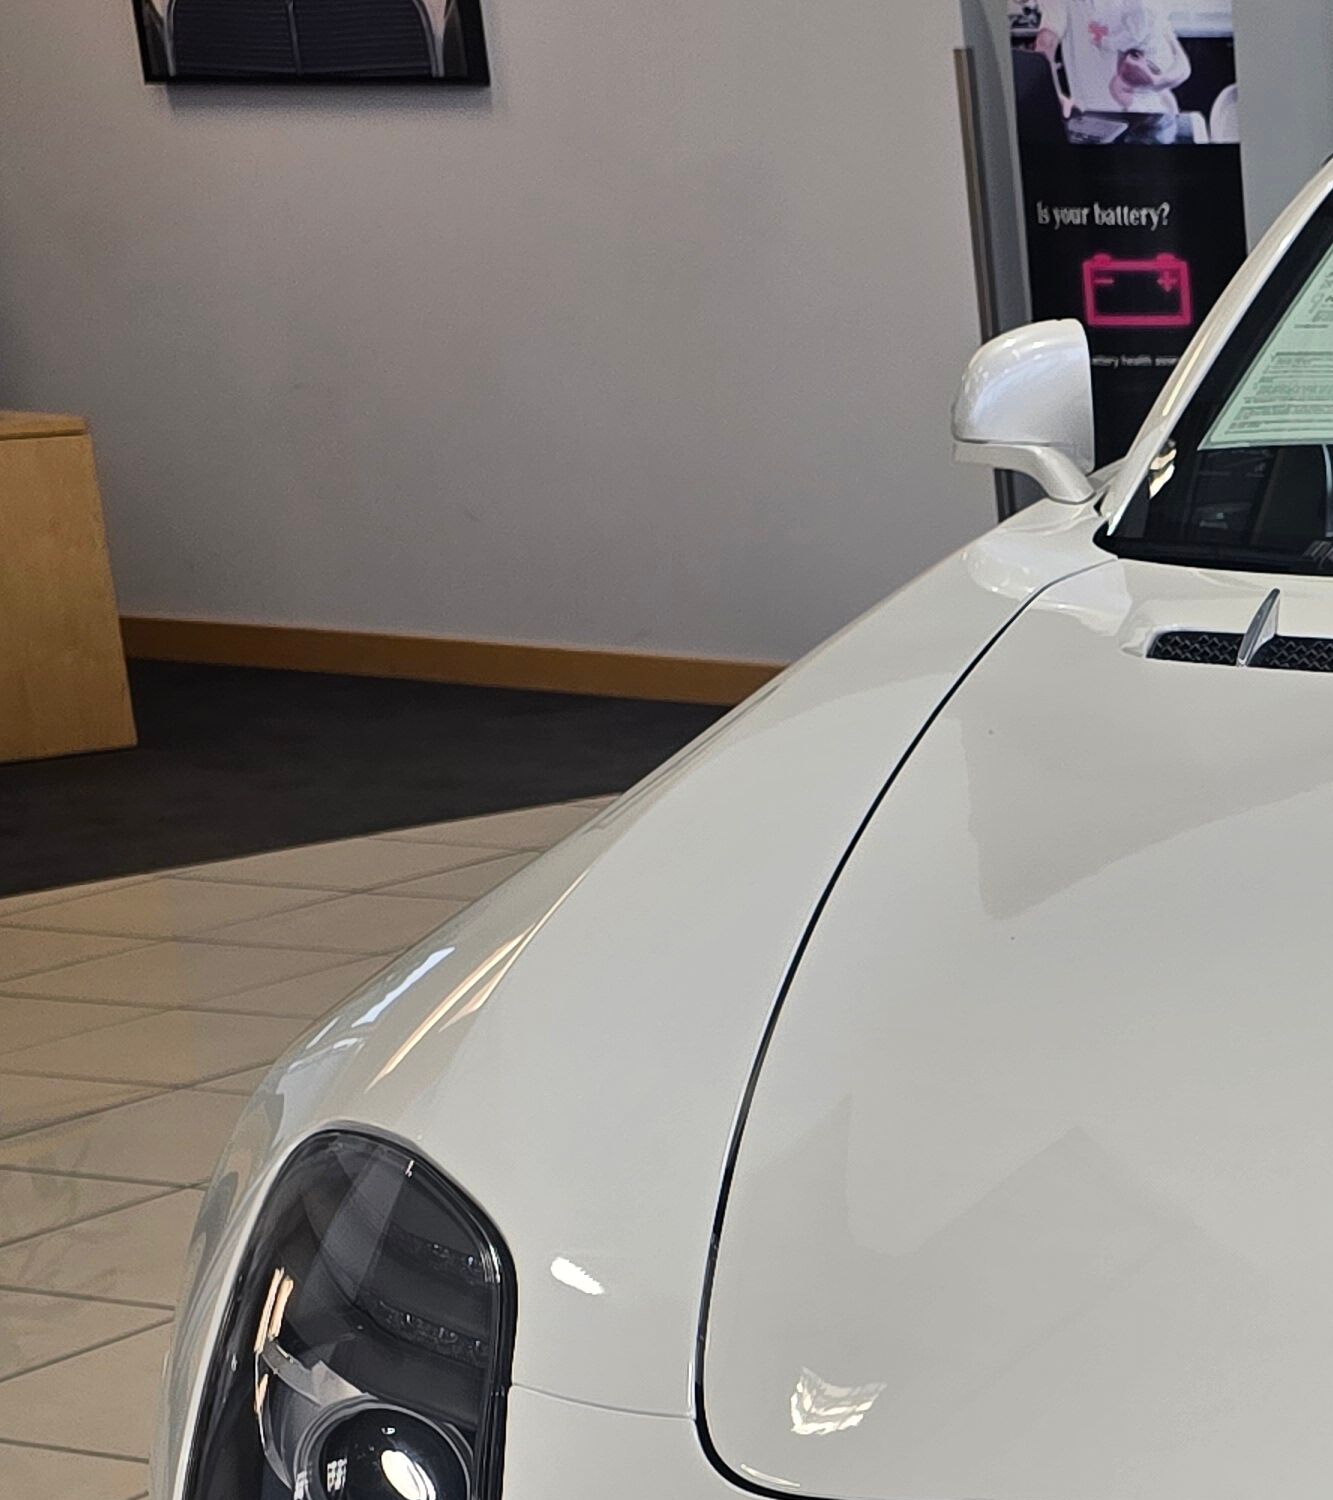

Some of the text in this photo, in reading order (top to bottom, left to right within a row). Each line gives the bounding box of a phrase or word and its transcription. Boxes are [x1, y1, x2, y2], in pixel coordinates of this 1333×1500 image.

[1036, 200, 1170, 231] Is your battery?
